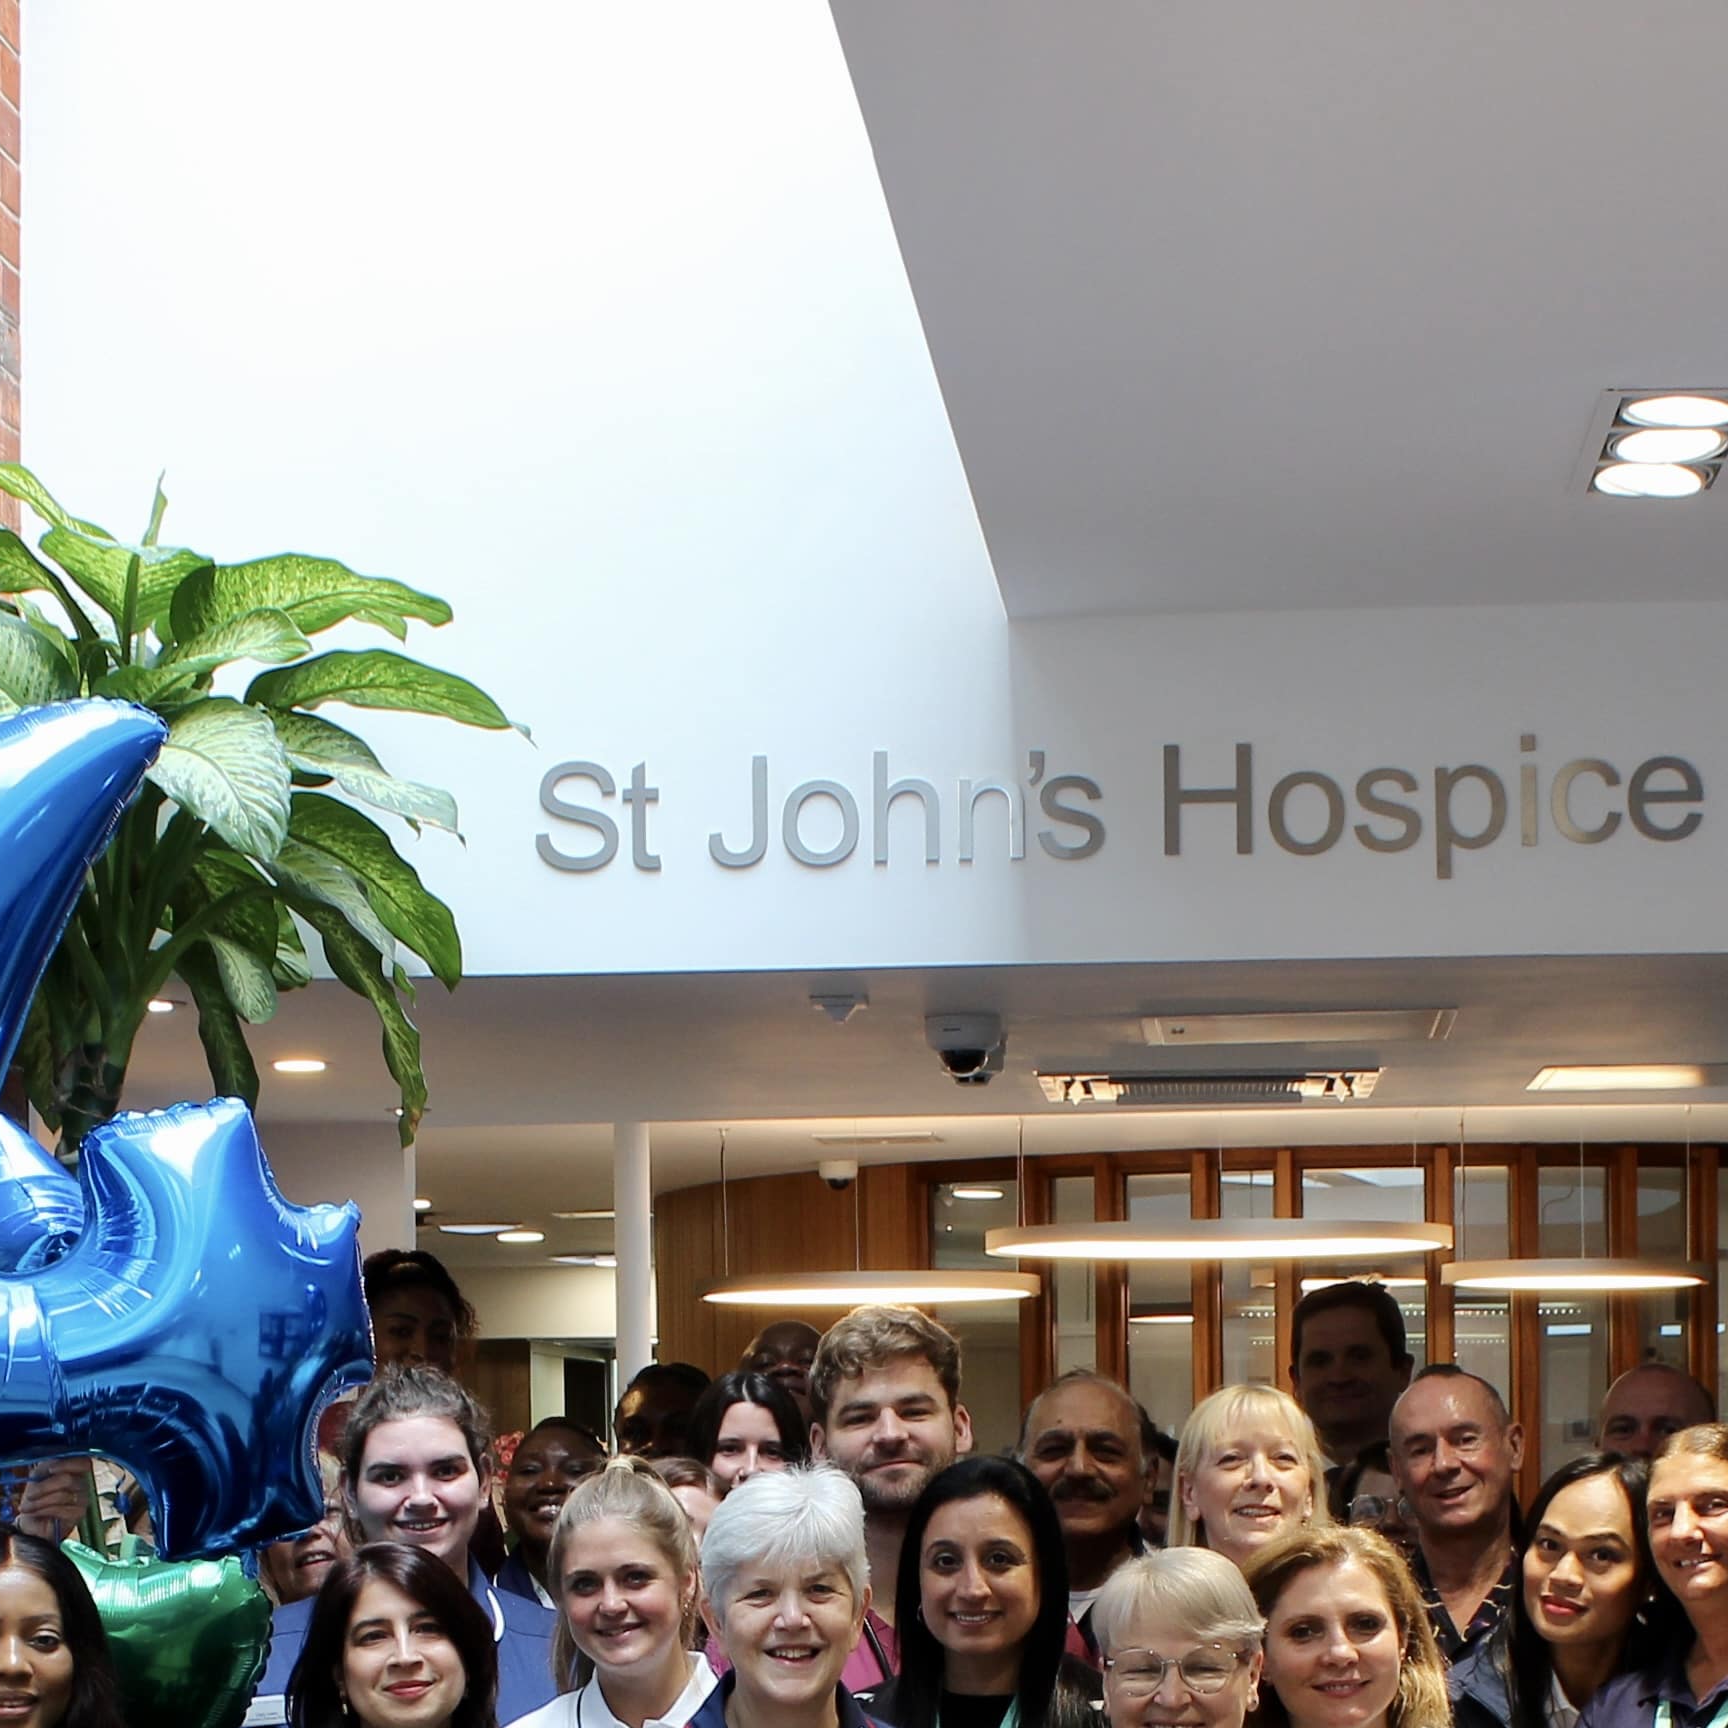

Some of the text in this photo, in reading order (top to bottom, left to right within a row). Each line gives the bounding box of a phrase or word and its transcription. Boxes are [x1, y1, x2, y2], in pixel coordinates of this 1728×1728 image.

[535, 733, 1706, 879] St John's Hospice
